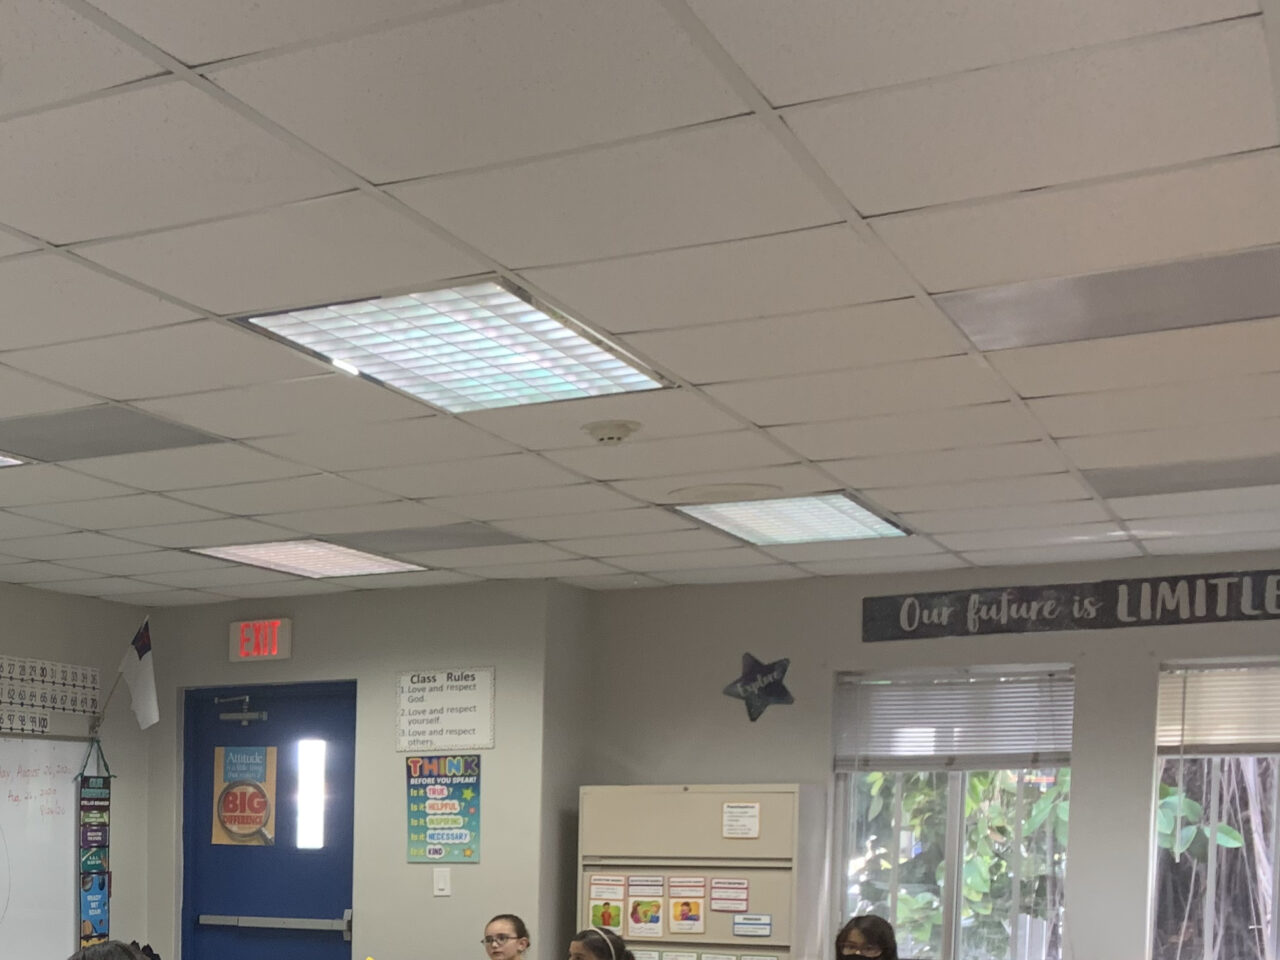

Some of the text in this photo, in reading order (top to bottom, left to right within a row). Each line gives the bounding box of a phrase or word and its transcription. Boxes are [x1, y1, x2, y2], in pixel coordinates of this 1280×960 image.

[899, 575, 1280, 632] Our future is LIMITLE
[240, 620, 280, 657] EXIT
[410, 672, 475, 684] Class Rules
[447, 706, 476, 714] respect
[227, 752, 262, 763] Attitude
[408, 757, 478, 776] THINK
[428, 787, 445, 795] TRUE
[224, 791, 267, 813] BIG
[428, 802, 458, 811] HELPFUL
